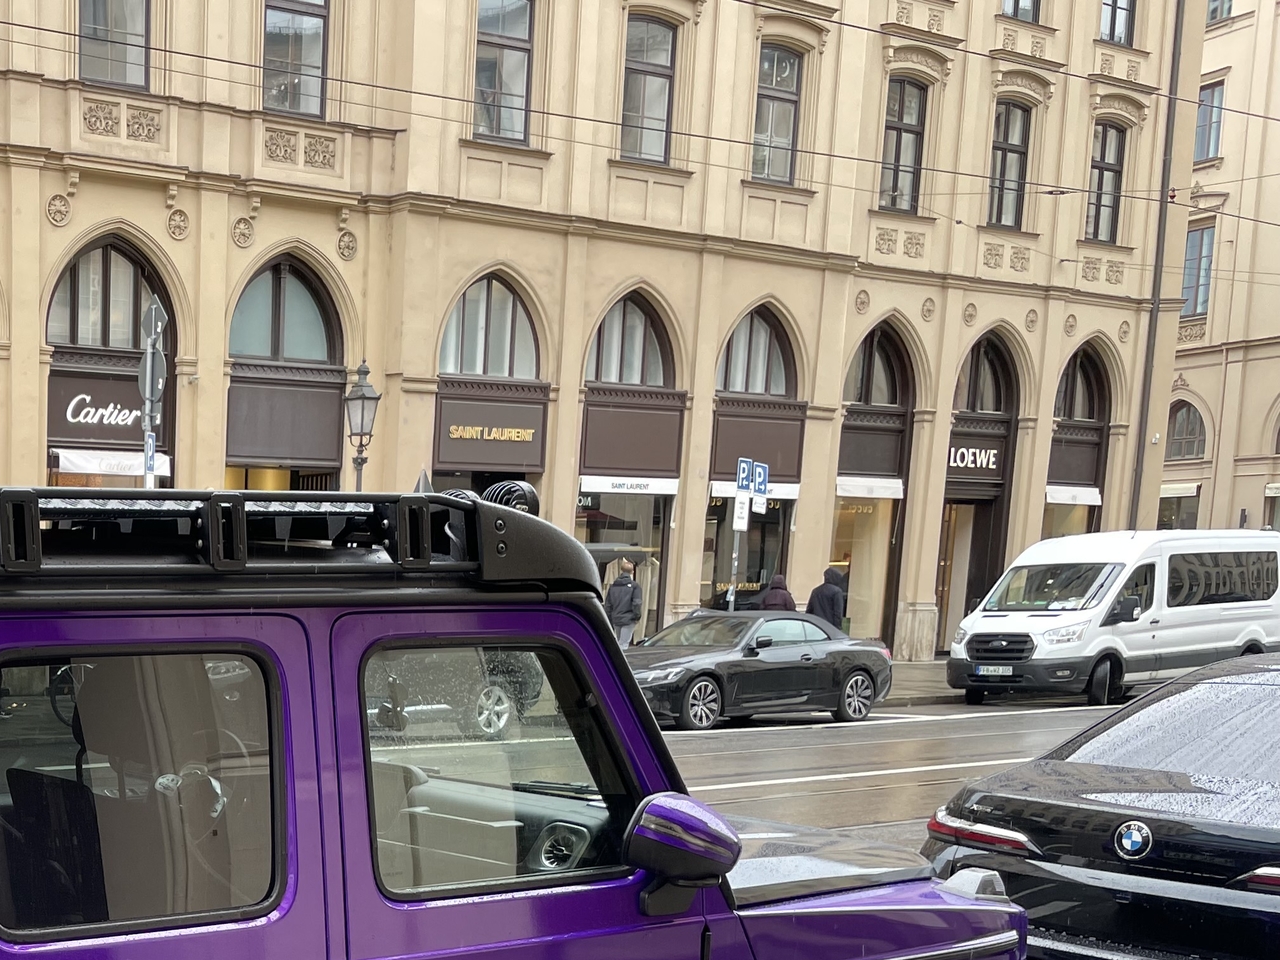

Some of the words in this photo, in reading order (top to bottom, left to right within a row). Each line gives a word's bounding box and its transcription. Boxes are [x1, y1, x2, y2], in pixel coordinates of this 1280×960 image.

[66, 394, 141, 425] Cartier
[449, 425, 483, 439] SAINT
[483, 427, 535, 442] LAURENT
[949, 447, 998, 469] LOEWE
[1121, 824, 1148, 838] BMW
